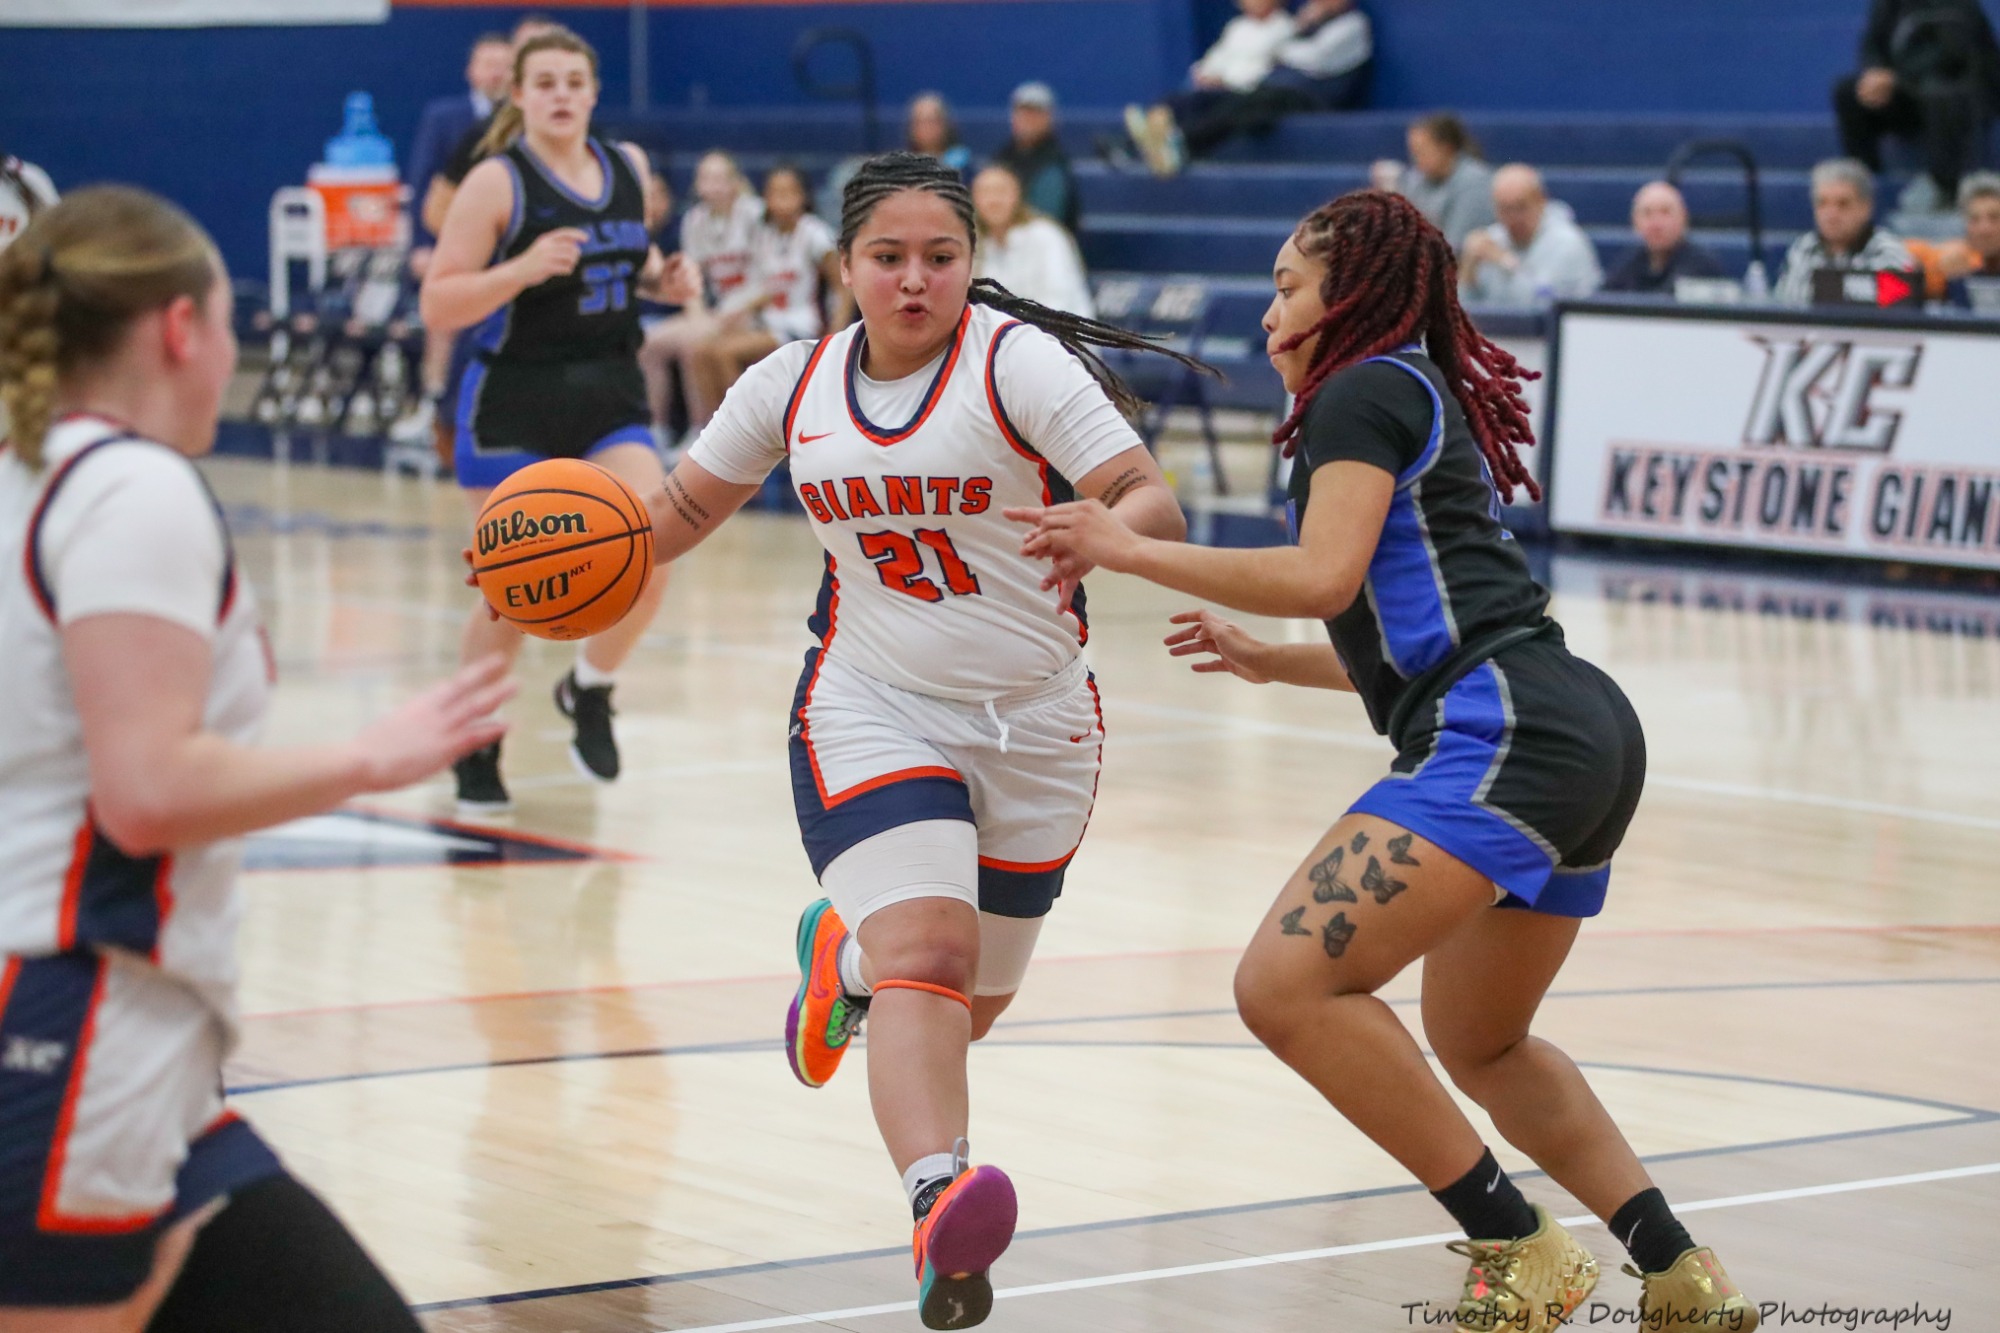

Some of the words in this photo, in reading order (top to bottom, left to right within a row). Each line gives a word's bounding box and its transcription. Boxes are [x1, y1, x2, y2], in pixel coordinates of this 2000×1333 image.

[579, 262, 631, 314] 31
[1744, 333, 1924, 454] KC
[799, 475, 993, 524] GIANTS
[1606, 450, 1849, 534] KEYSTONE
[1872, 472, 2000, 545] GIAN
[477, 510, 588, 556] Wilson
[570, 560, 593, 578] NXT
[856, 527, 982, 603] 21
